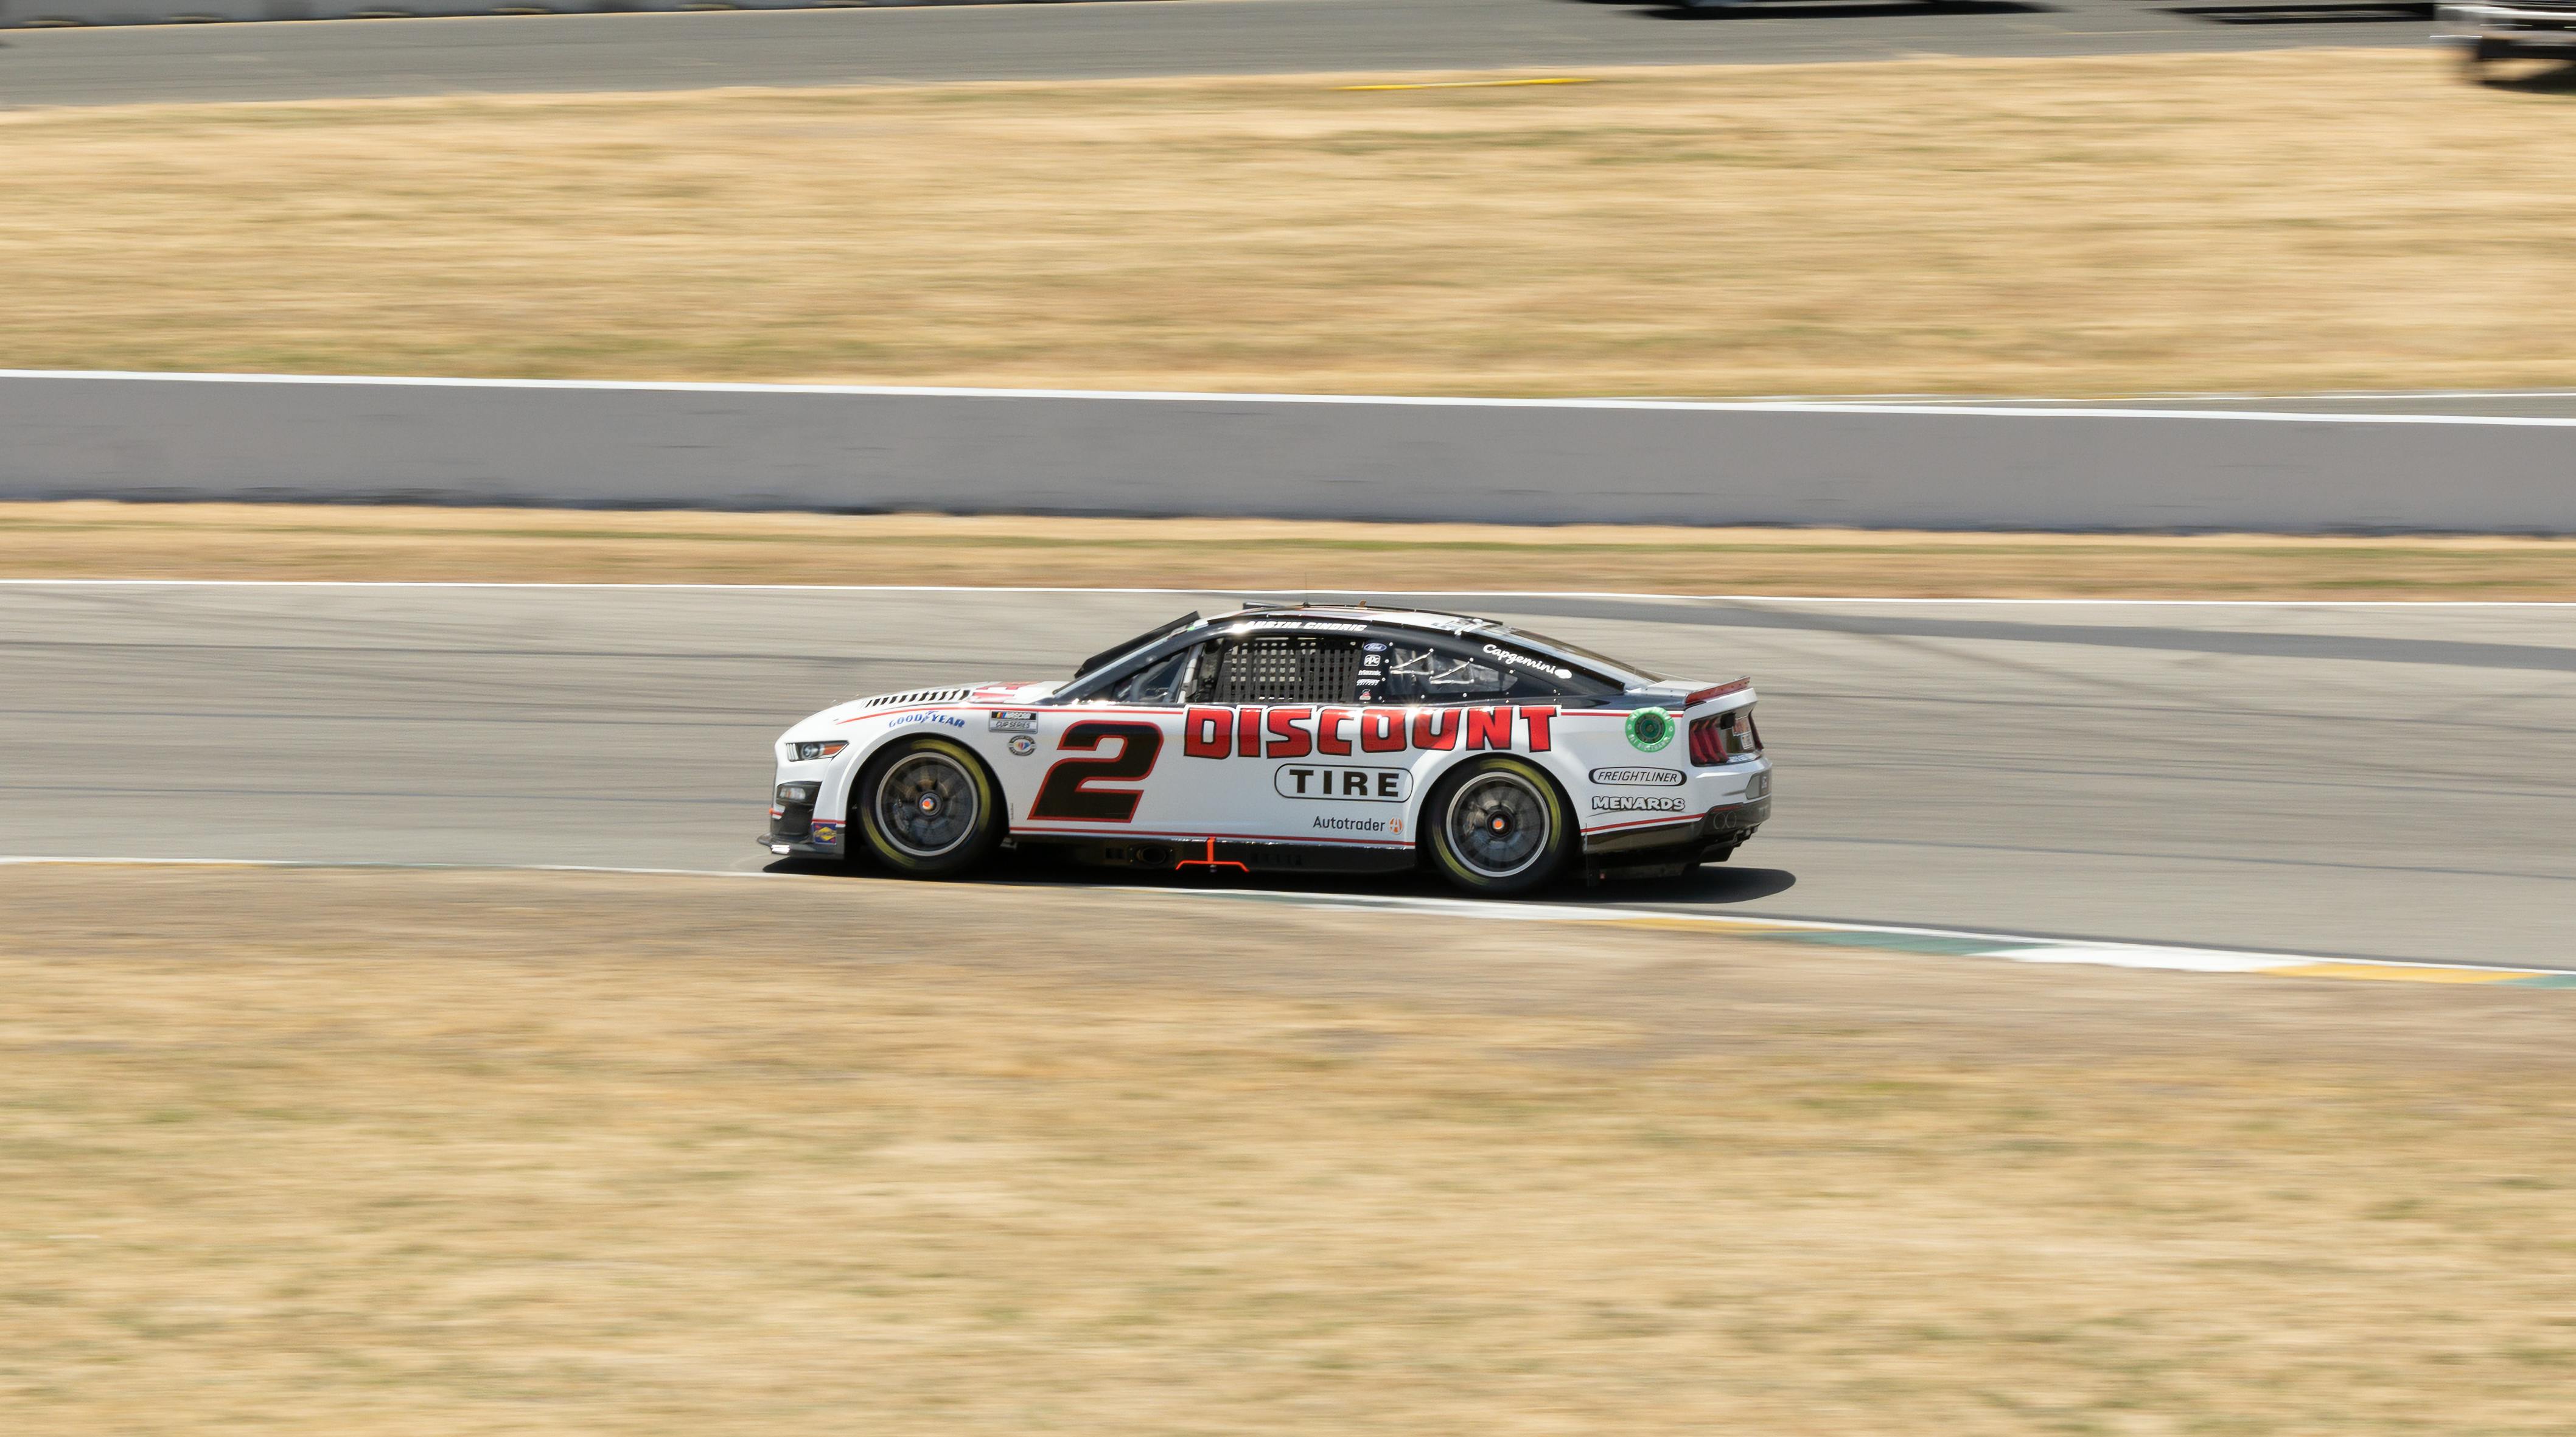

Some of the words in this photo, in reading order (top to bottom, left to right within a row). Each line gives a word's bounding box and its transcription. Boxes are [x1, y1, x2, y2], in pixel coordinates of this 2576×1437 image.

[1248, 621, 1302, 629] AUSTIN
[1304, 622, 1368, 632] CINDRIC
[1482, 644, 1556, 674] Capgemini
[1183, 705, 1557, 760] DISCOUNT
[1027, 720, 1164, 823] 2
[1597, 771, 1678, 782] FREIGHTLINER
[1289, 769, 1400, 798] TIRE
[1591, 796, 1686, 812] MENARDS
[1313, 815, 1386, 832] Autotrader
